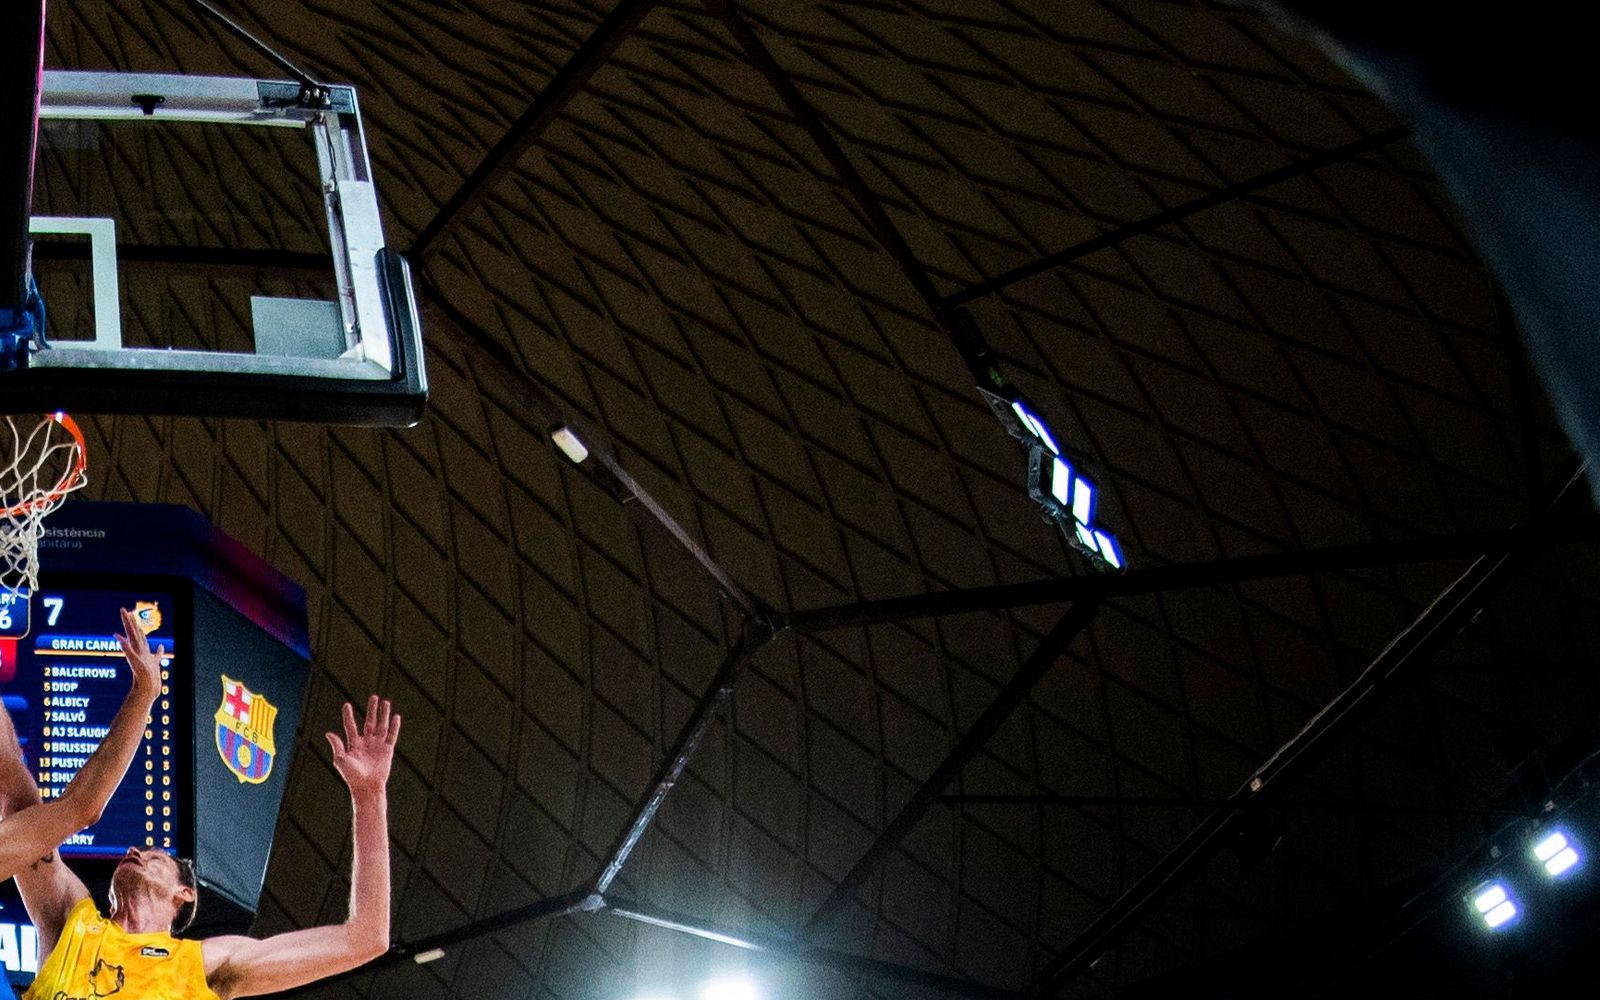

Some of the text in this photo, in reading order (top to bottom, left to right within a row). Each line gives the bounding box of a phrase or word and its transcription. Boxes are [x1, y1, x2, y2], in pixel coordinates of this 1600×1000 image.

[43, 598, 63, 626] 7
[52, 640, 83, 650] GRAN
[52, 667, 116, 678] BALCEROWS
[52, 682, 78, 692] DIOP
[52, 697, 89, 707] ALBICY
[52, 710, 86, 722] SALVÓ
[52, 727, 65, 737] AJ
[67, 728, 110, 738] SLAUGH
[52, 742, 99, 753] BRUSSIN
[52, 758, 87, 768] PUSTO
